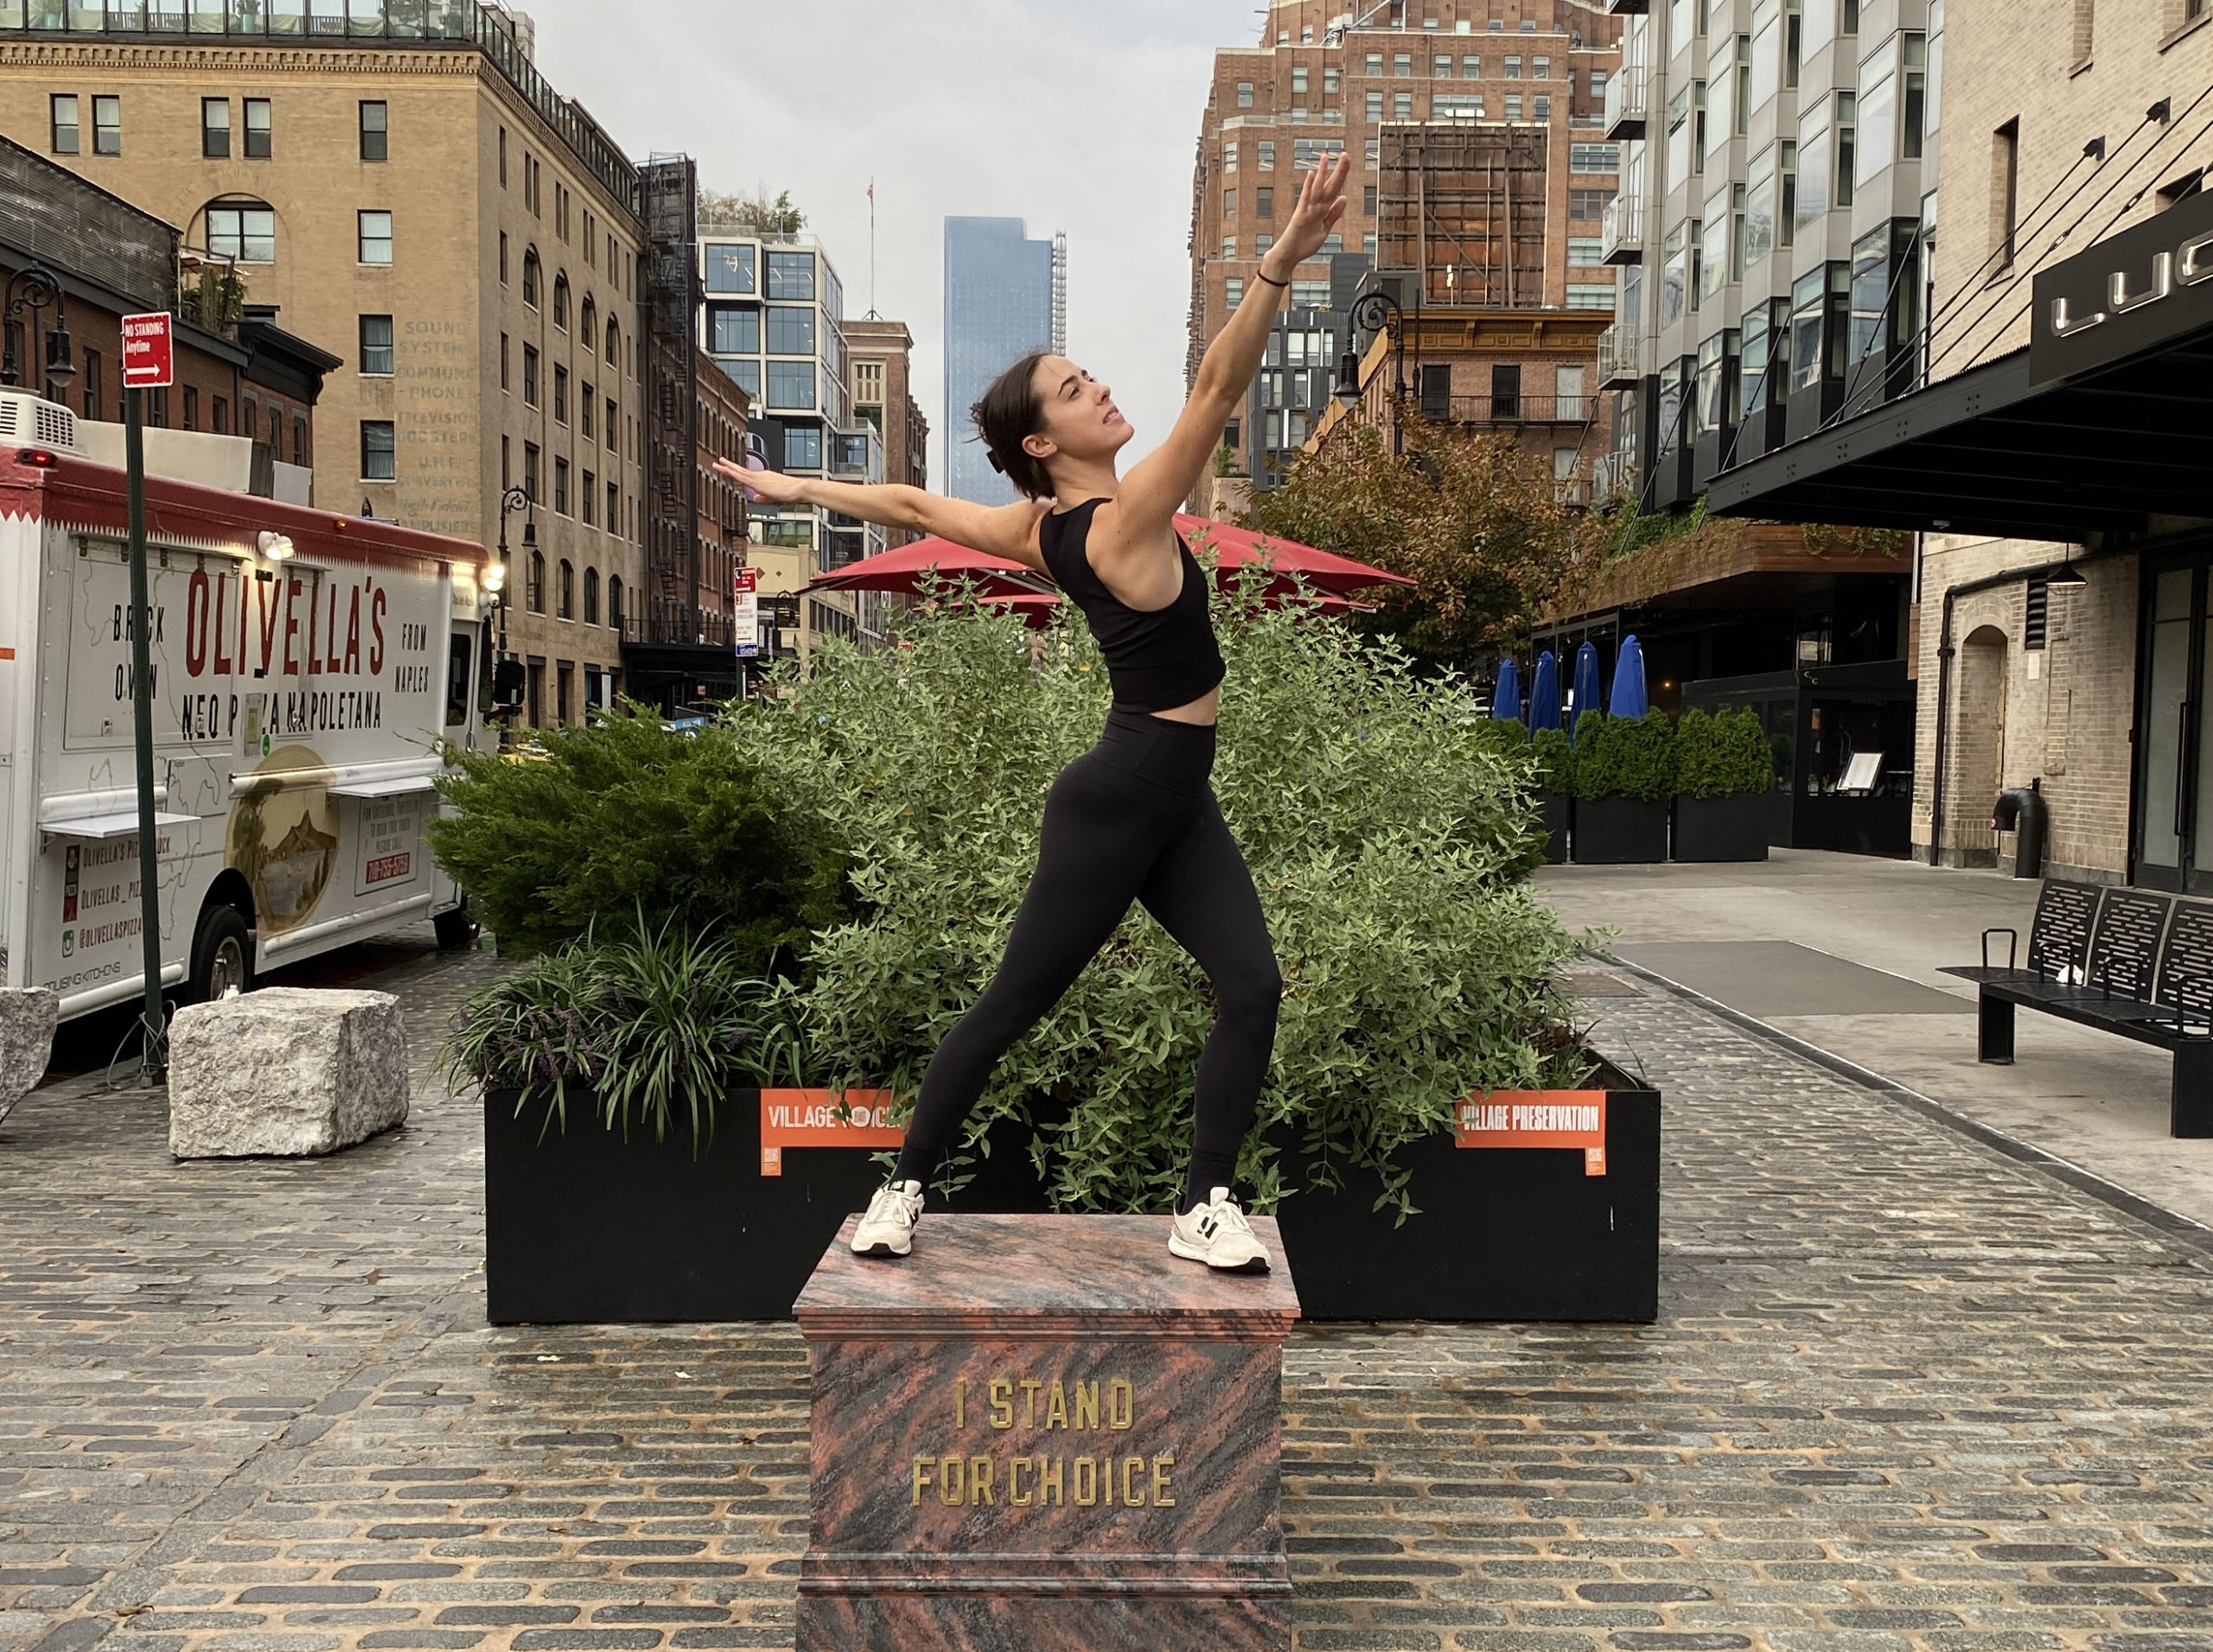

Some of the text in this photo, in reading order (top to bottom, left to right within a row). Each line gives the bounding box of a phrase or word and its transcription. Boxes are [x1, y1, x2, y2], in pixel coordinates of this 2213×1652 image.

[125, 322, 164, 336] NO STANDING
[126, 339, 150, 356] Anytime
[113, 604, 164, 642] BRCK
[186, 568, 386, 678] OLIVELLA'S
[402, 623, 426, 651] FROM
[115, 664, 156, 701] OVN
[395, 666, 429, 693] NAPLES
[182, 693, 219, 740] NEO
[287, 691, 380, 733] NAPOLETANA
[83, 837, 171, 868] OLIVELLA'S PIZ UCK
[129, 880, 142, 899] PIZ
[768, 1106, 835, 1128] VILLAGE
[1462, 1105, 1599, 1132] VILLAGE PRESERVATION
[955, 1379, 1133, 1430] I STAND
[912, 1455, 1176, 1507] FOR CHOICE
